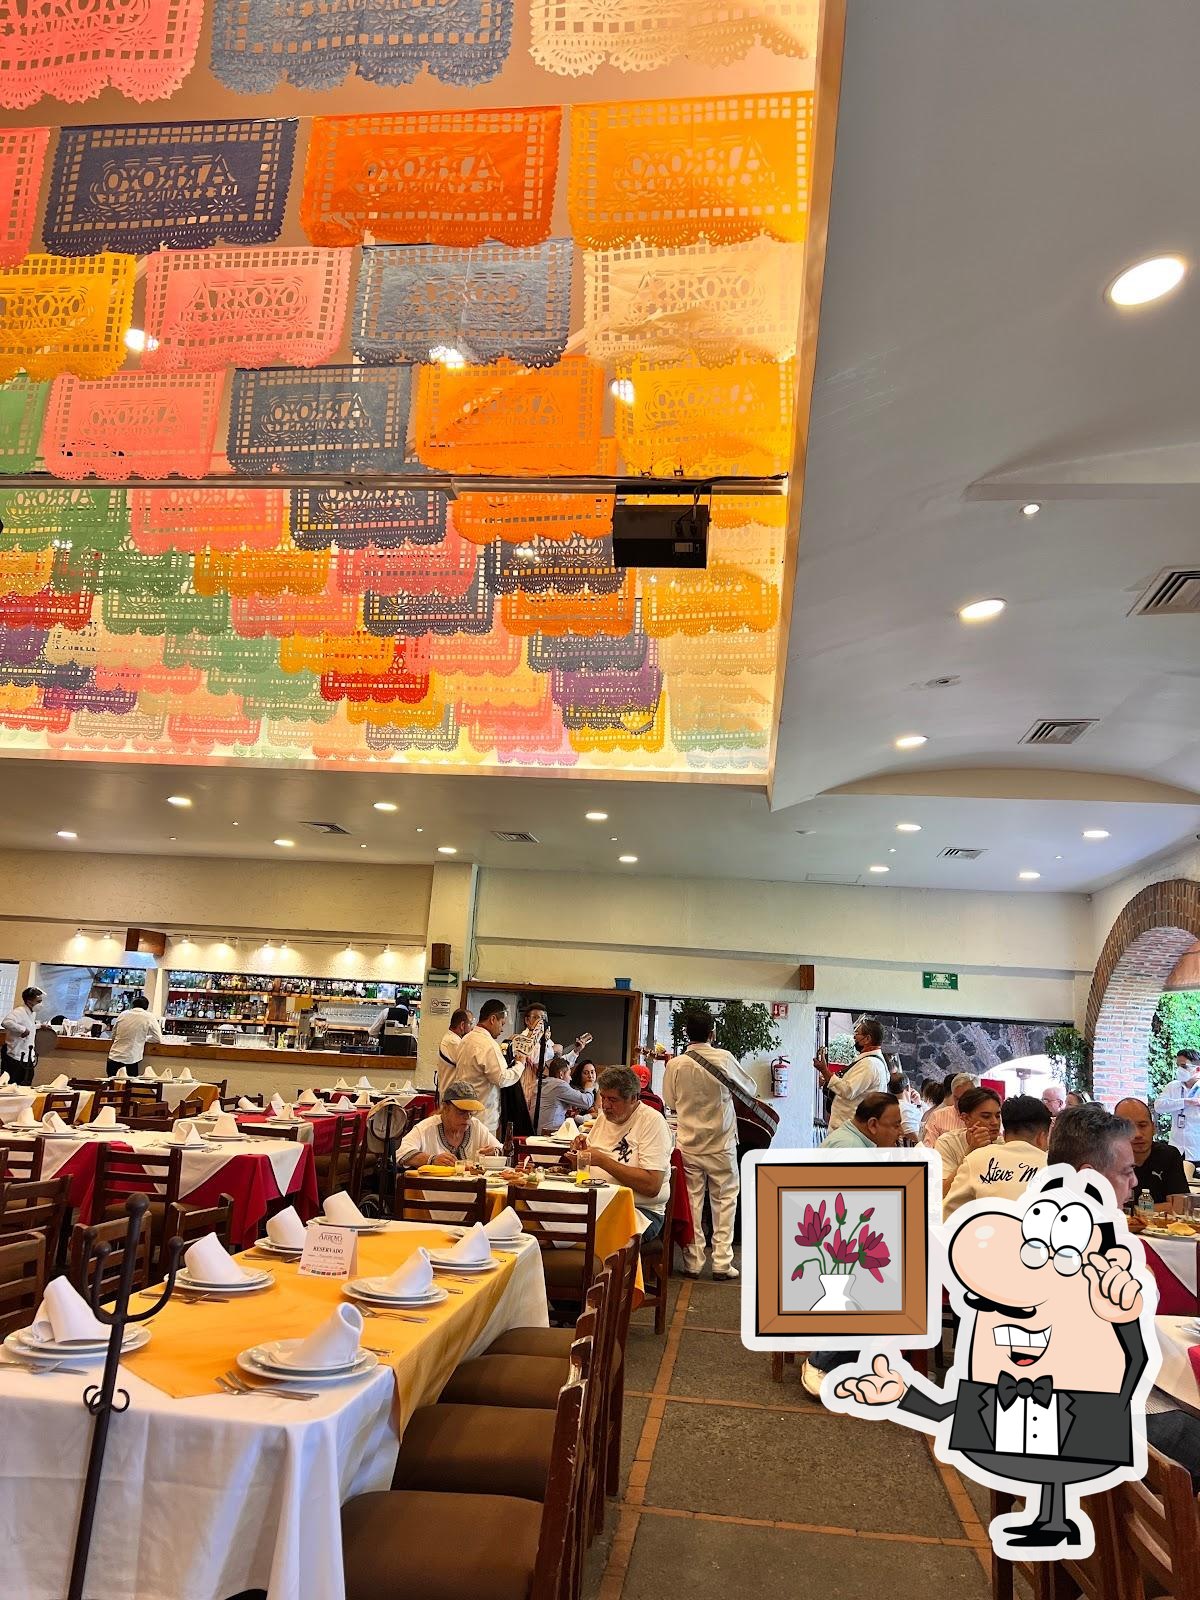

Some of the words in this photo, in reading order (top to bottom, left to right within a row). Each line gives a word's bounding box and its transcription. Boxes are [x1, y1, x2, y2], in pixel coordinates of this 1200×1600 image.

[184, 281, 299, 309] ARROYO
[631, 271, 752, 302] ARROYO
[2, 294, 85, 317] RROYO
[178, 307, 301, 322] RESTAURANTE
[312, 1246, 344, 1255] RESERVADO
